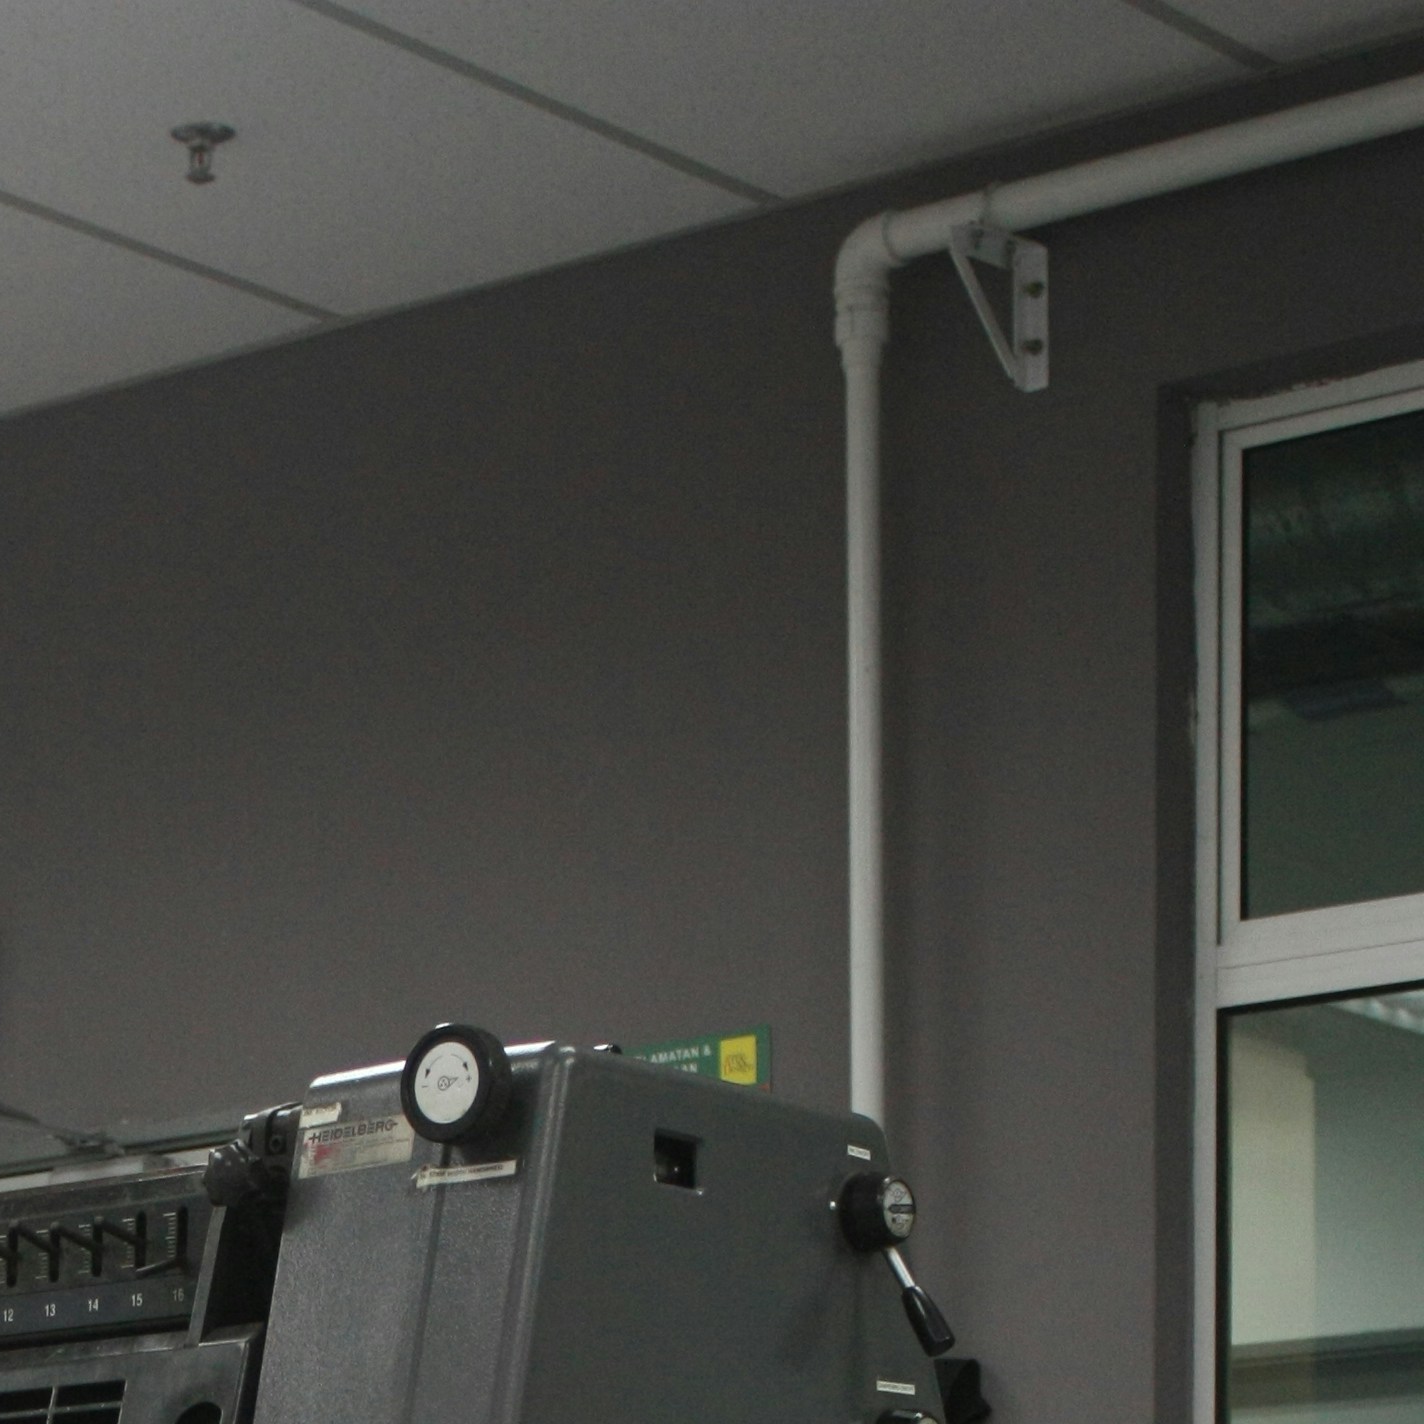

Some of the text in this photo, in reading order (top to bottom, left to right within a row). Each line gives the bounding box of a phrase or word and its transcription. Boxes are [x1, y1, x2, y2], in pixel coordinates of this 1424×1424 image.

[308, 1119, 398, 1145] HEIDELBERG
[3, 1308, 14, 1322] 12
[44, 1303, 56, 1318] 13
[87, 1298, 99, 1313] 14
[131, 1293, 143, 1307] 15
[172, 1288, 184, 1302] 16
